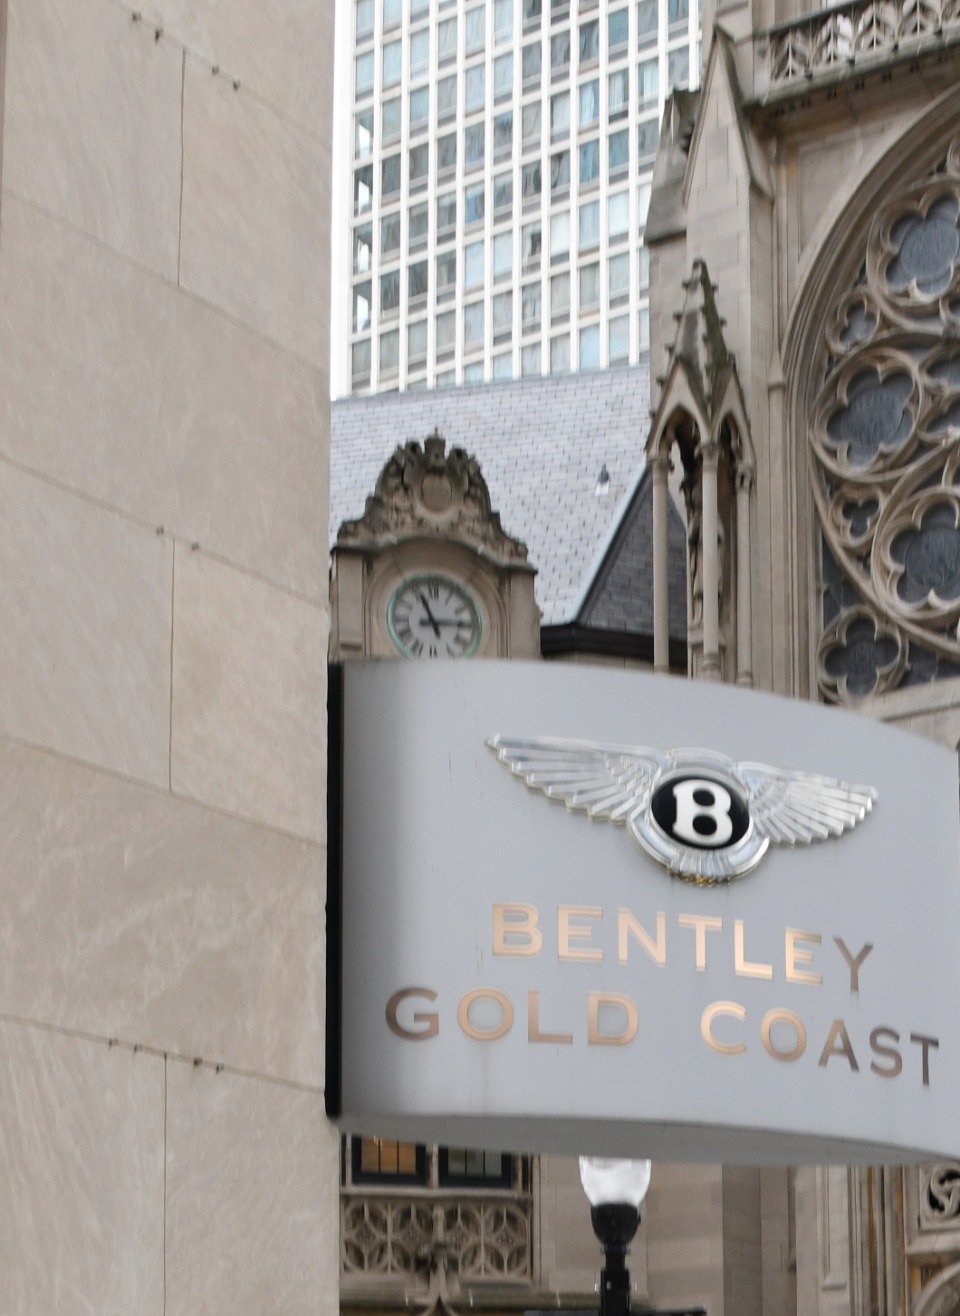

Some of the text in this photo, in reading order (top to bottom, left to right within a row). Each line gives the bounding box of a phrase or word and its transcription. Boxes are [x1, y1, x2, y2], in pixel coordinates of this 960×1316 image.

[673, 780, 732, 847] B
[492, 903, 874, 993] BENTLEY
[385, 986, 939, 1086] GOLD COAST
